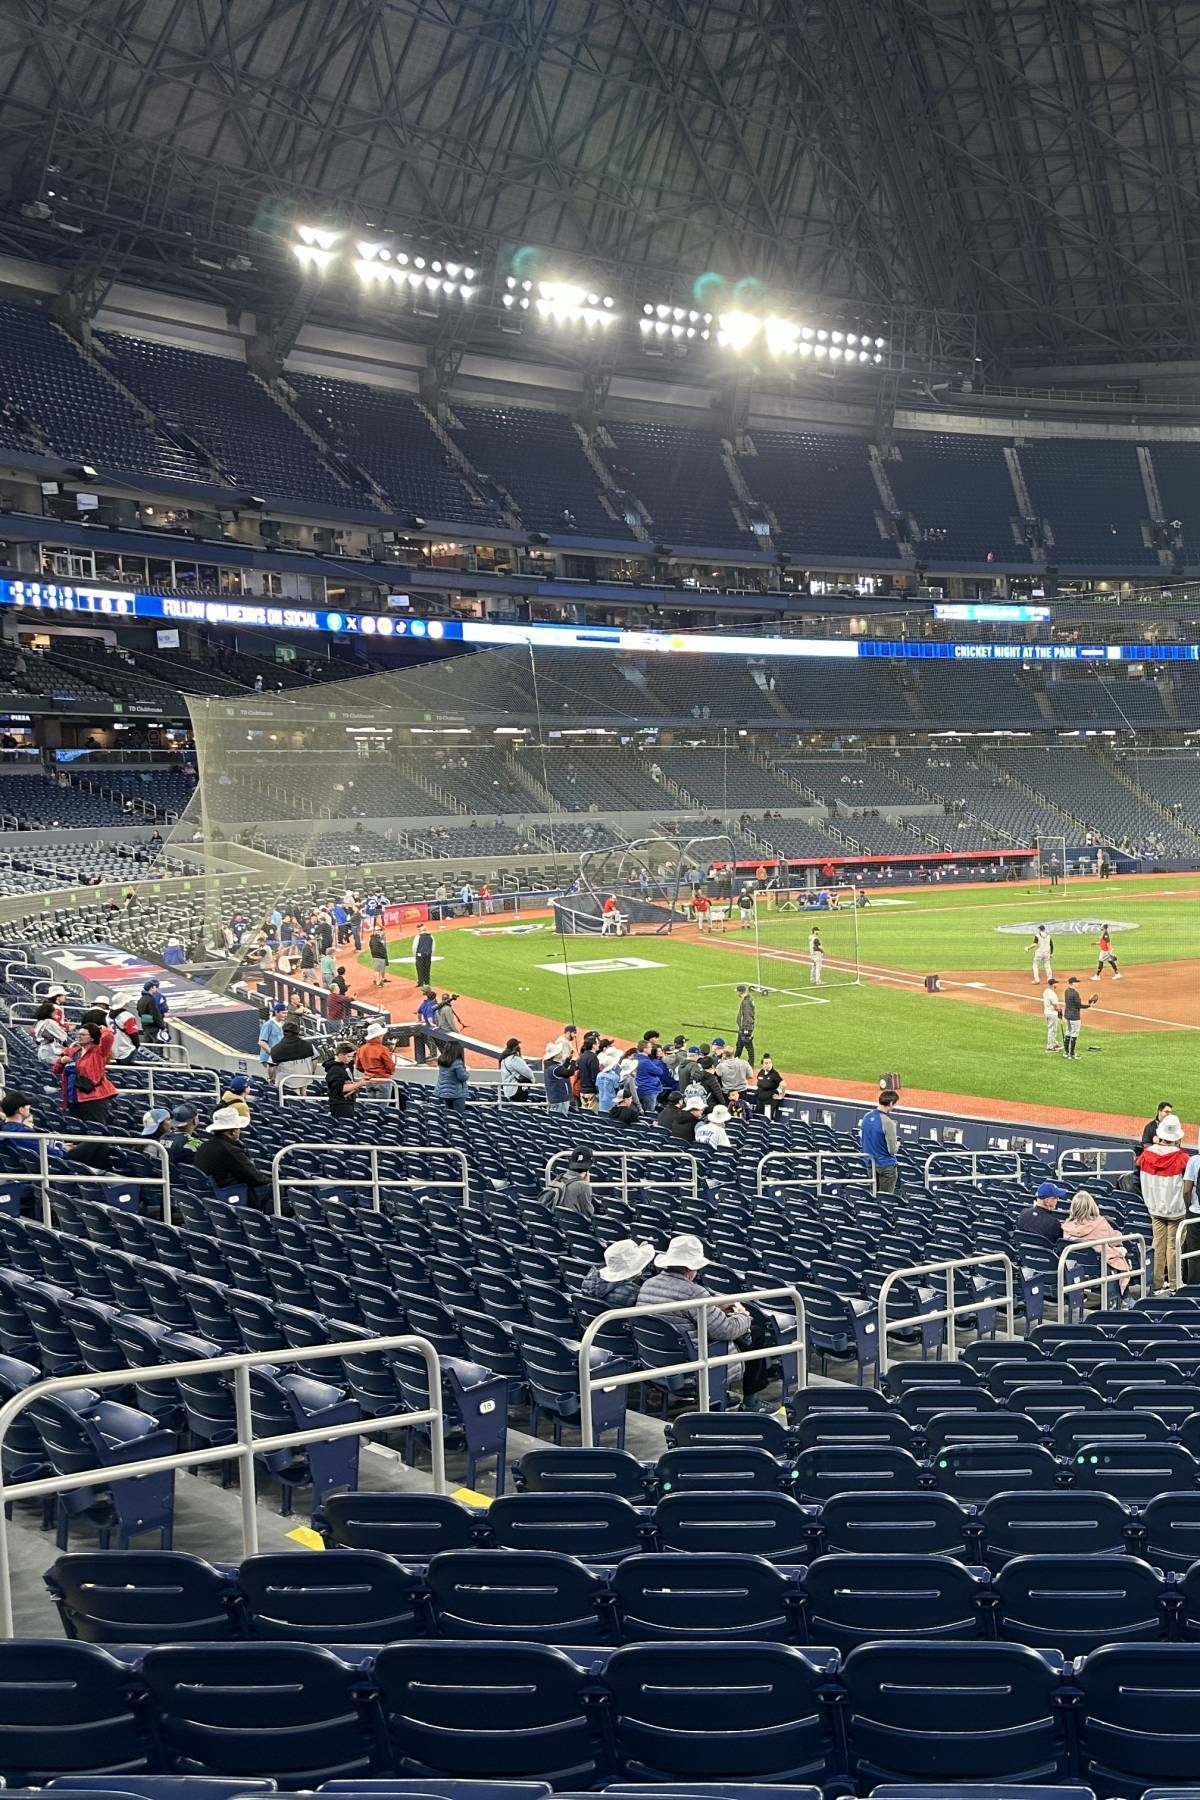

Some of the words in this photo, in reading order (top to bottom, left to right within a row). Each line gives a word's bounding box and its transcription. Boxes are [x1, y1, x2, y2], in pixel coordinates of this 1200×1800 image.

[954, 646, 992, 658] CRICKET
[994, 646, 1020, 658] NIGHT
[1022, 646, 1034, 658] AT
[1035, 646, 1052, 658] THE
[1053, 646, 1077, 658] PARK
